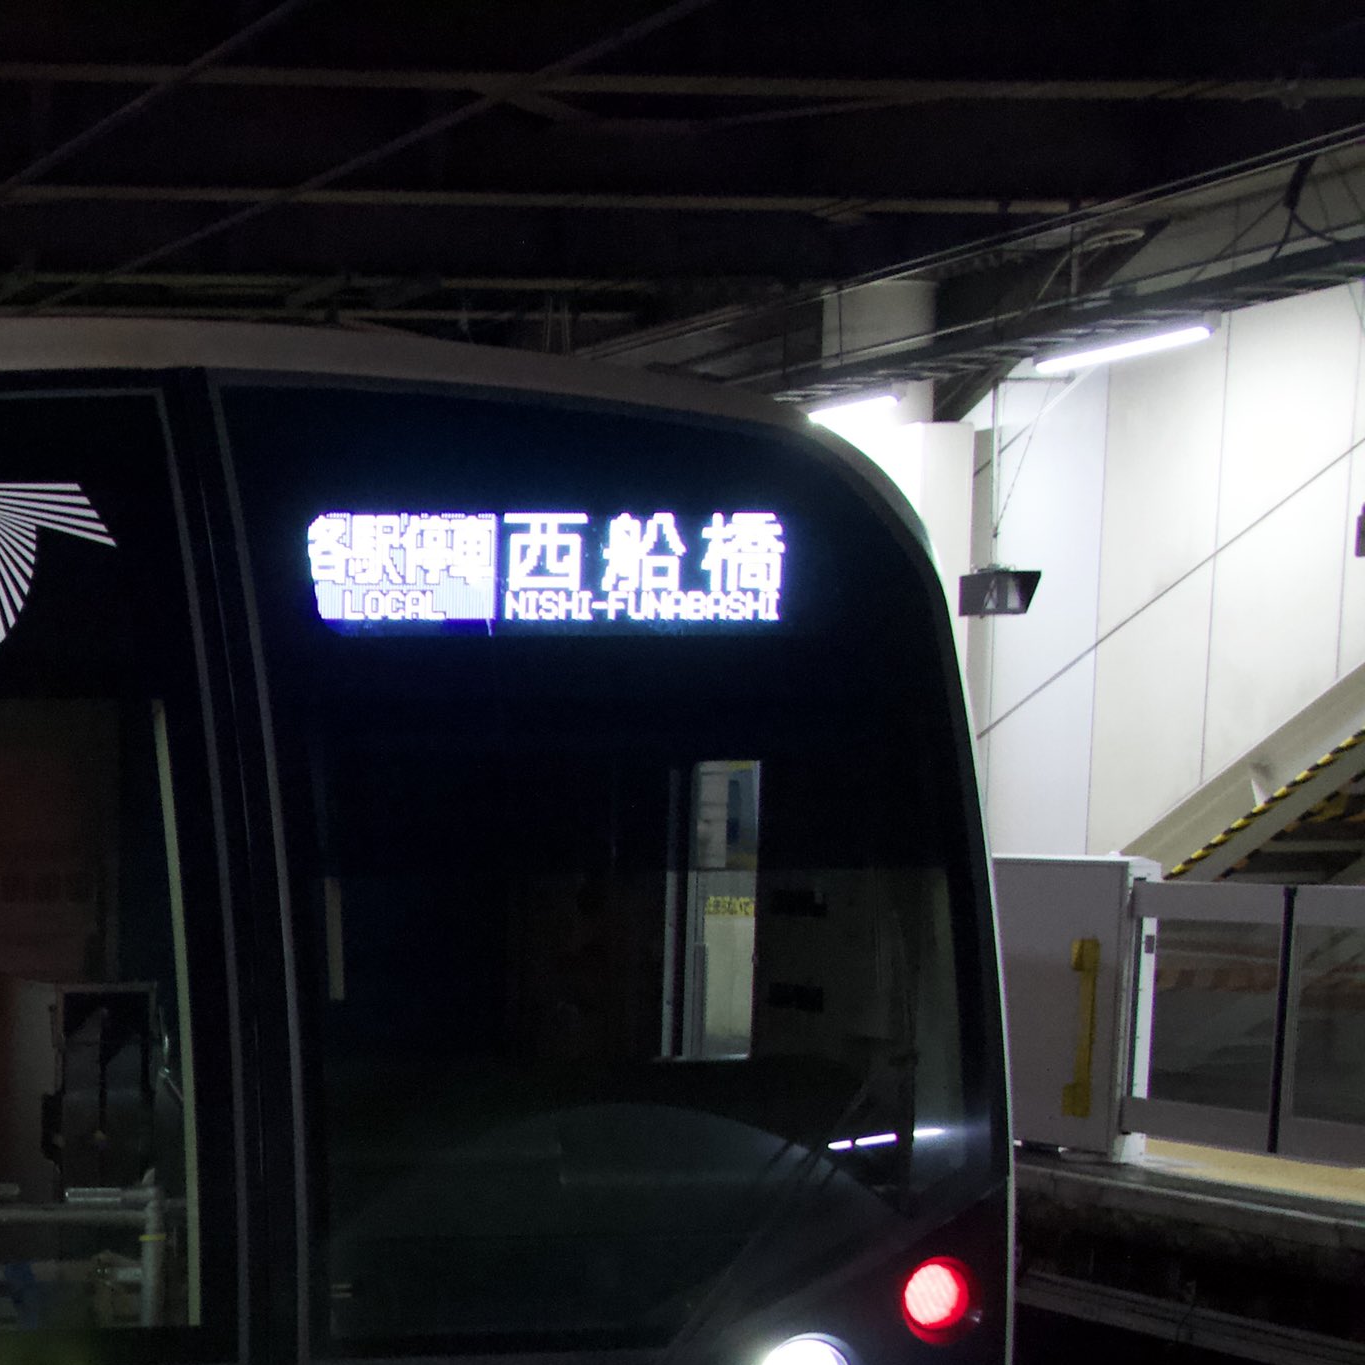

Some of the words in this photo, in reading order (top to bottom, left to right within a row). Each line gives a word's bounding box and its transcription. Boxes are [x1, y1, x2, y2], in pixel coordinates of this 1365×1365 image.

[307, 513, 494, 586] 各駅停車
[503, 512, 785, 592] 西船橋
[343, 591, 446, 620] LOCAL
[504, 590, 782, 621] NISHI-FUNABASHI
